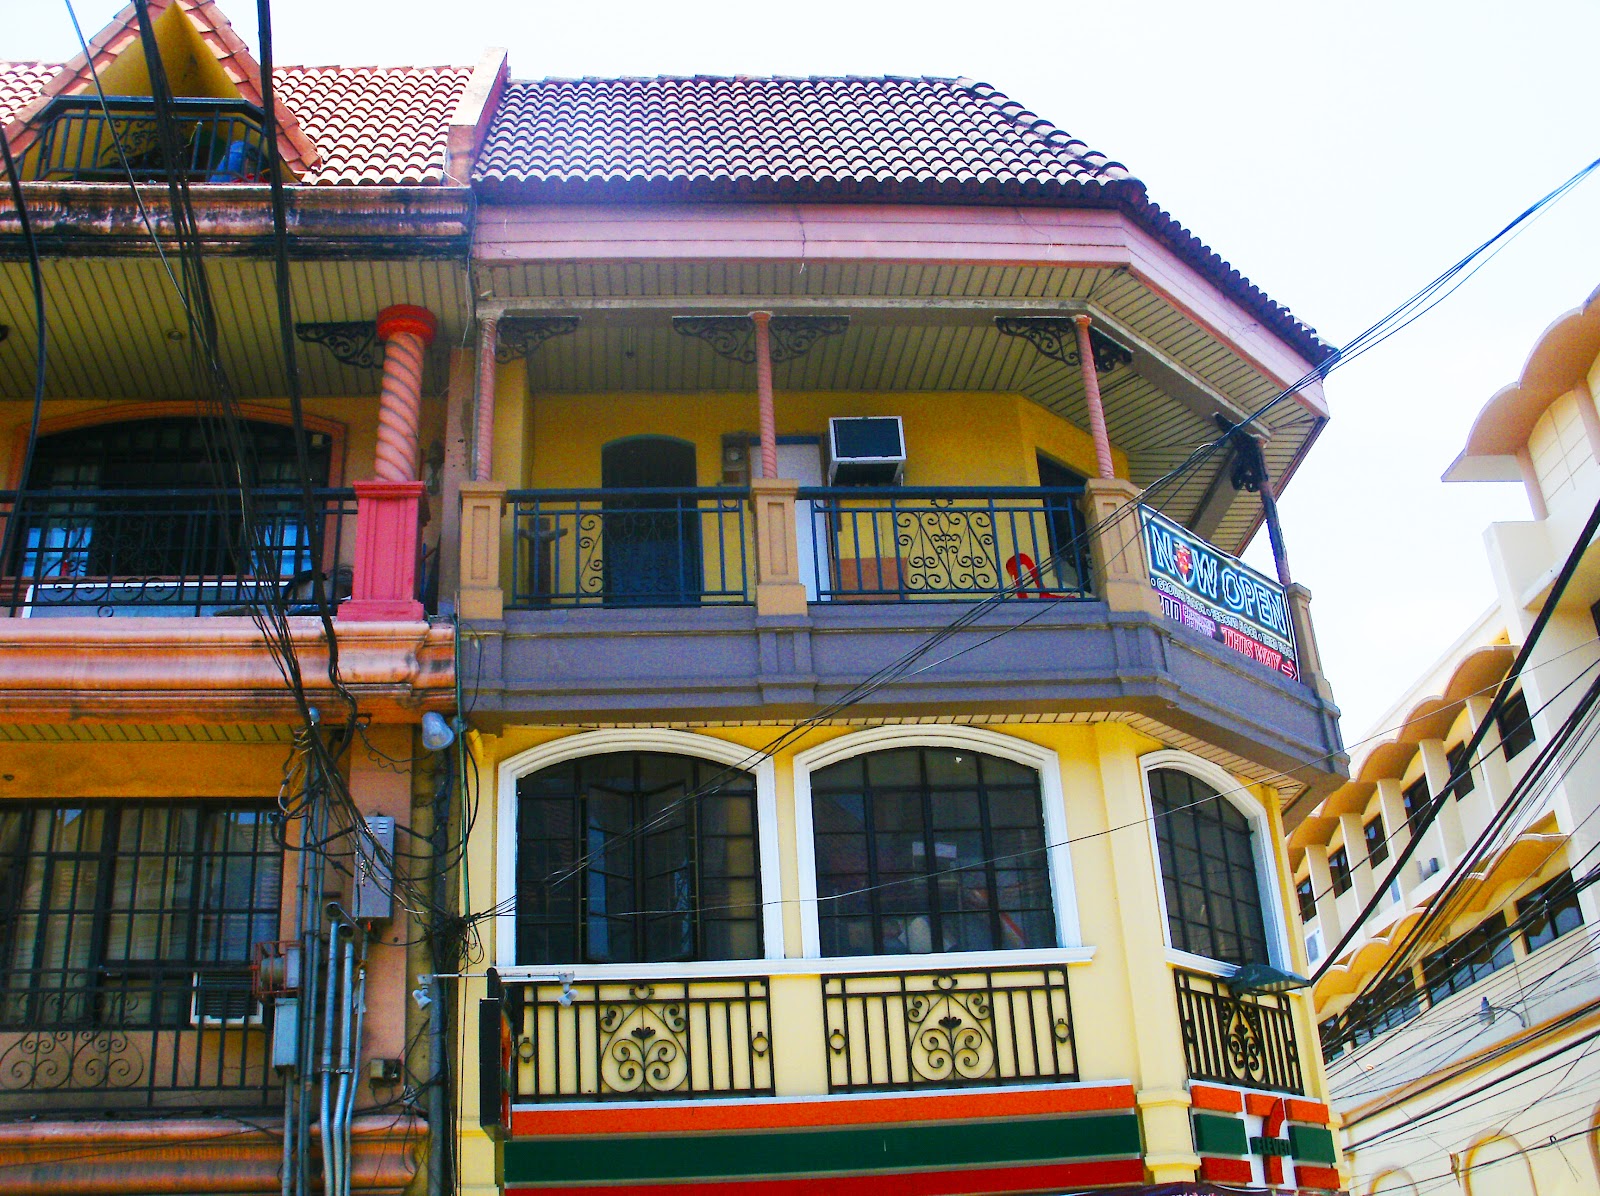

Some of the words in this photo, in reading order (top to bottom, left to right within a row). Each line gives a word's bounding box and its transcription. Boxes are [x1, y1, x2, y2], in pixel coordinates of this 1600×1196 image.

[1151, 525, 1218, 599] NOW
[1221, 567, 1288, 635] OPEN
[1221, 626, 1254, 659] THIS
[1254, 643, 1282, 671] WAY
[1245, 1094, 1285, 1184] 7
